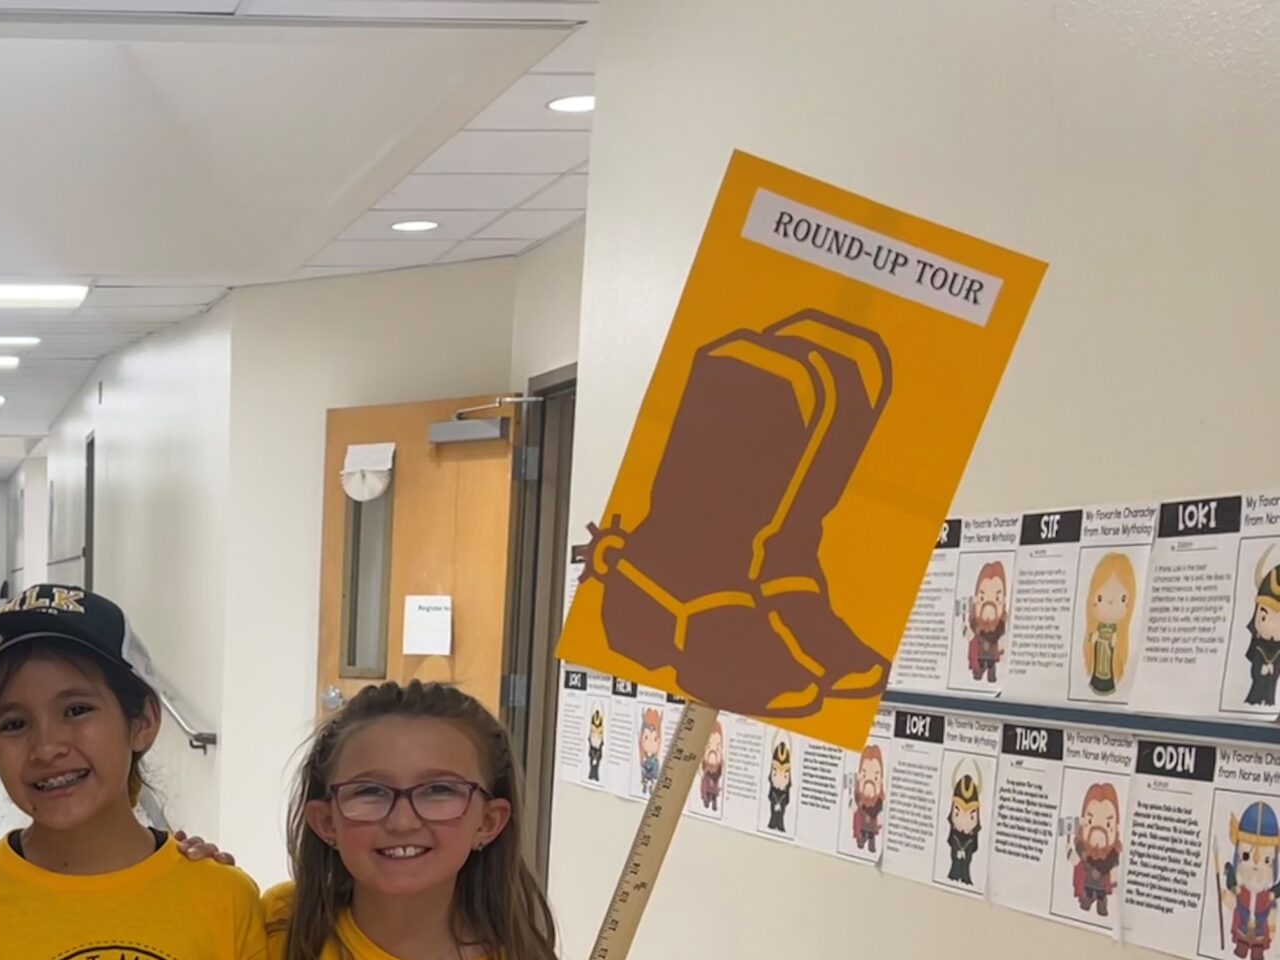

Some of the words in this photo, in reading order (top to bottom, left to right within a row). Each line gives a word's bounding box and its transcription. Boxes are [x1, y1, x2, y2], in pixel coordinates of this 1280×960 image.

[772, 210, 909, 277] ROUND-UP
[915, 259, 984, 305] TOUR
[1040, 514, 1061, 539] SIF
[1178, 501, 1217, 531] LOKI
[906, 714, 931, 737] LOKI
[1016, 727, 1048, 753] THOR
[1153, 746, 1196, 774] ODIN
